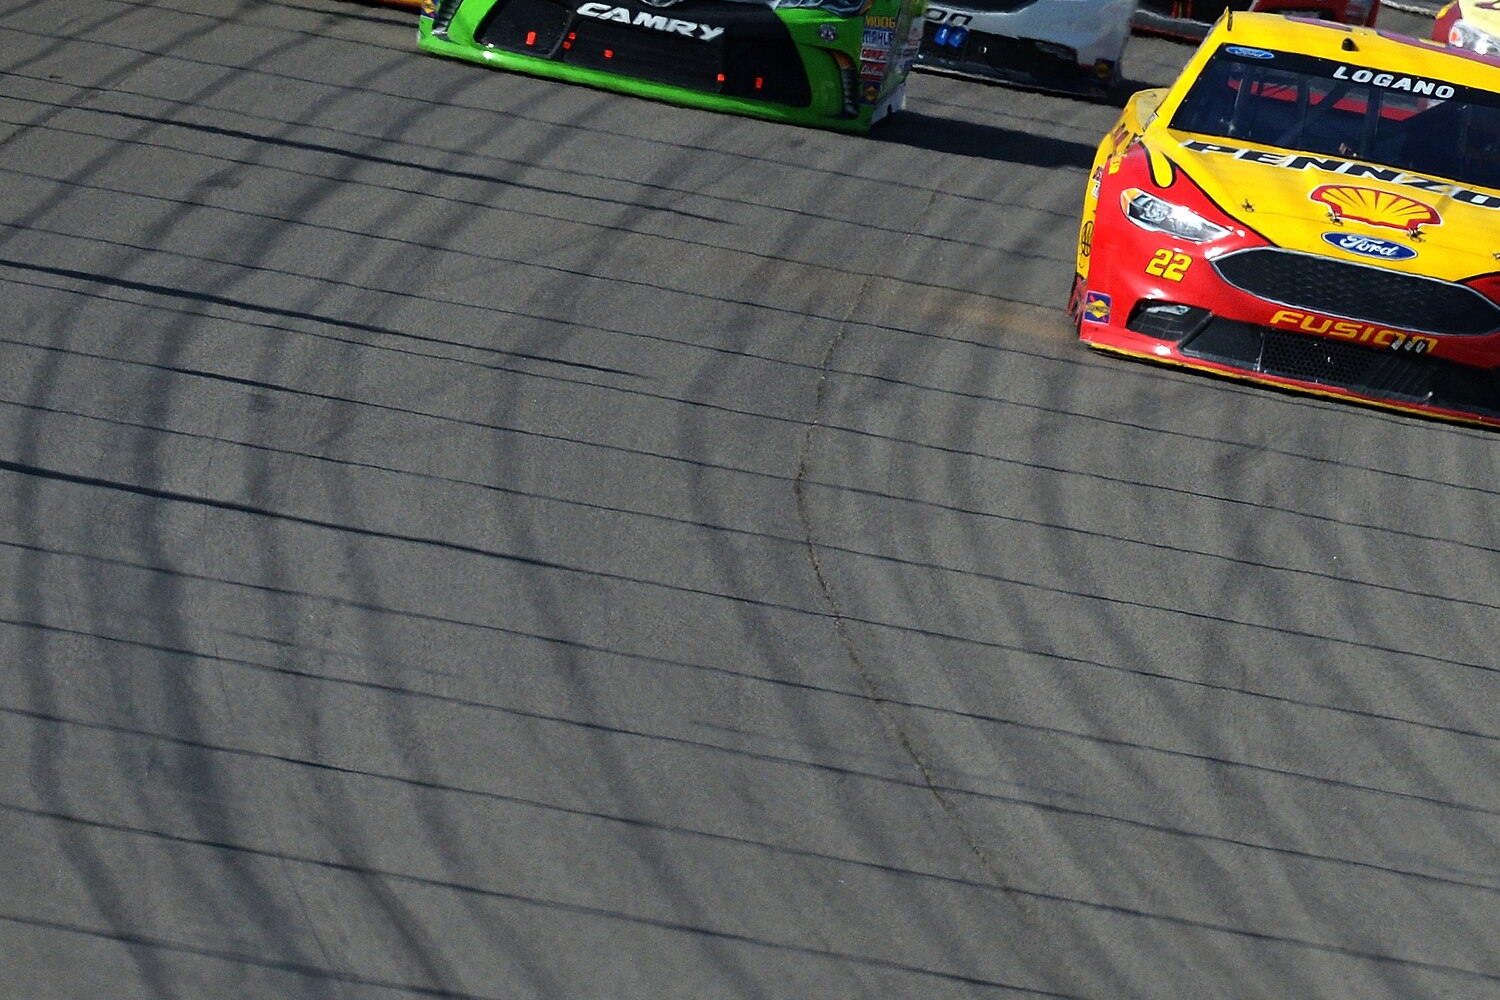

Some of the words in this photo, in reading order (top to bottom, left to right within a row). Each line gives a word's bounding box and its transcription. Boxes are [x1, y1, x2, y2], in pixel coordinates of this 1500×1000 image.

[576, 1, 726, 42] CAMRY
[866, 15, 896, 29] MOOG
[1333, 65, 1455, 100] LOGANO
[1338, 232, 1400, 257] Ford
[1145, 247, 1194, 283] 22
[1269, 309, 1439, 354] FUSION
